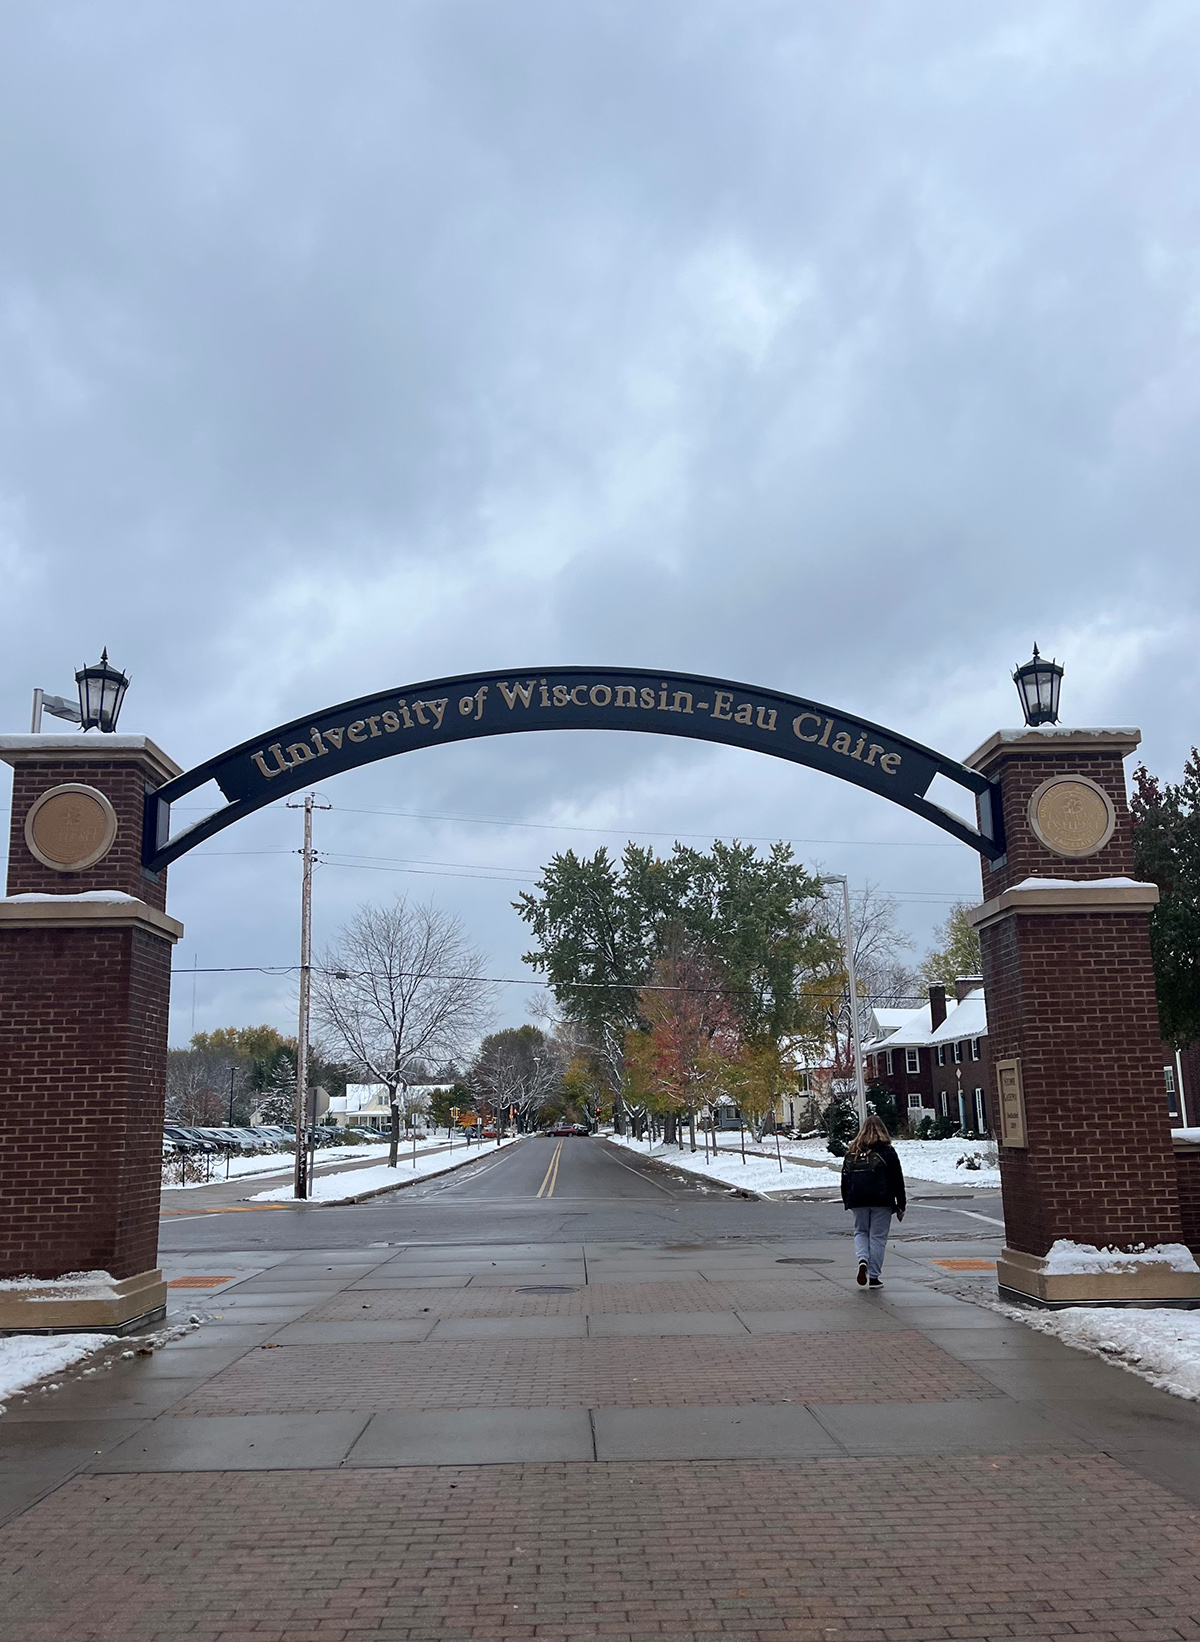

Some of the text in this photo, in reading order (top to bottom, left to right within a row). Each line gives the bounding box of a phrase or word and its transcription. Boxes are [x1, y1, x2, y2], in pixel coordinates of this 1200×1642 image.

[251, 678, 902, 777] University of Wisconsin-Eau Claire
